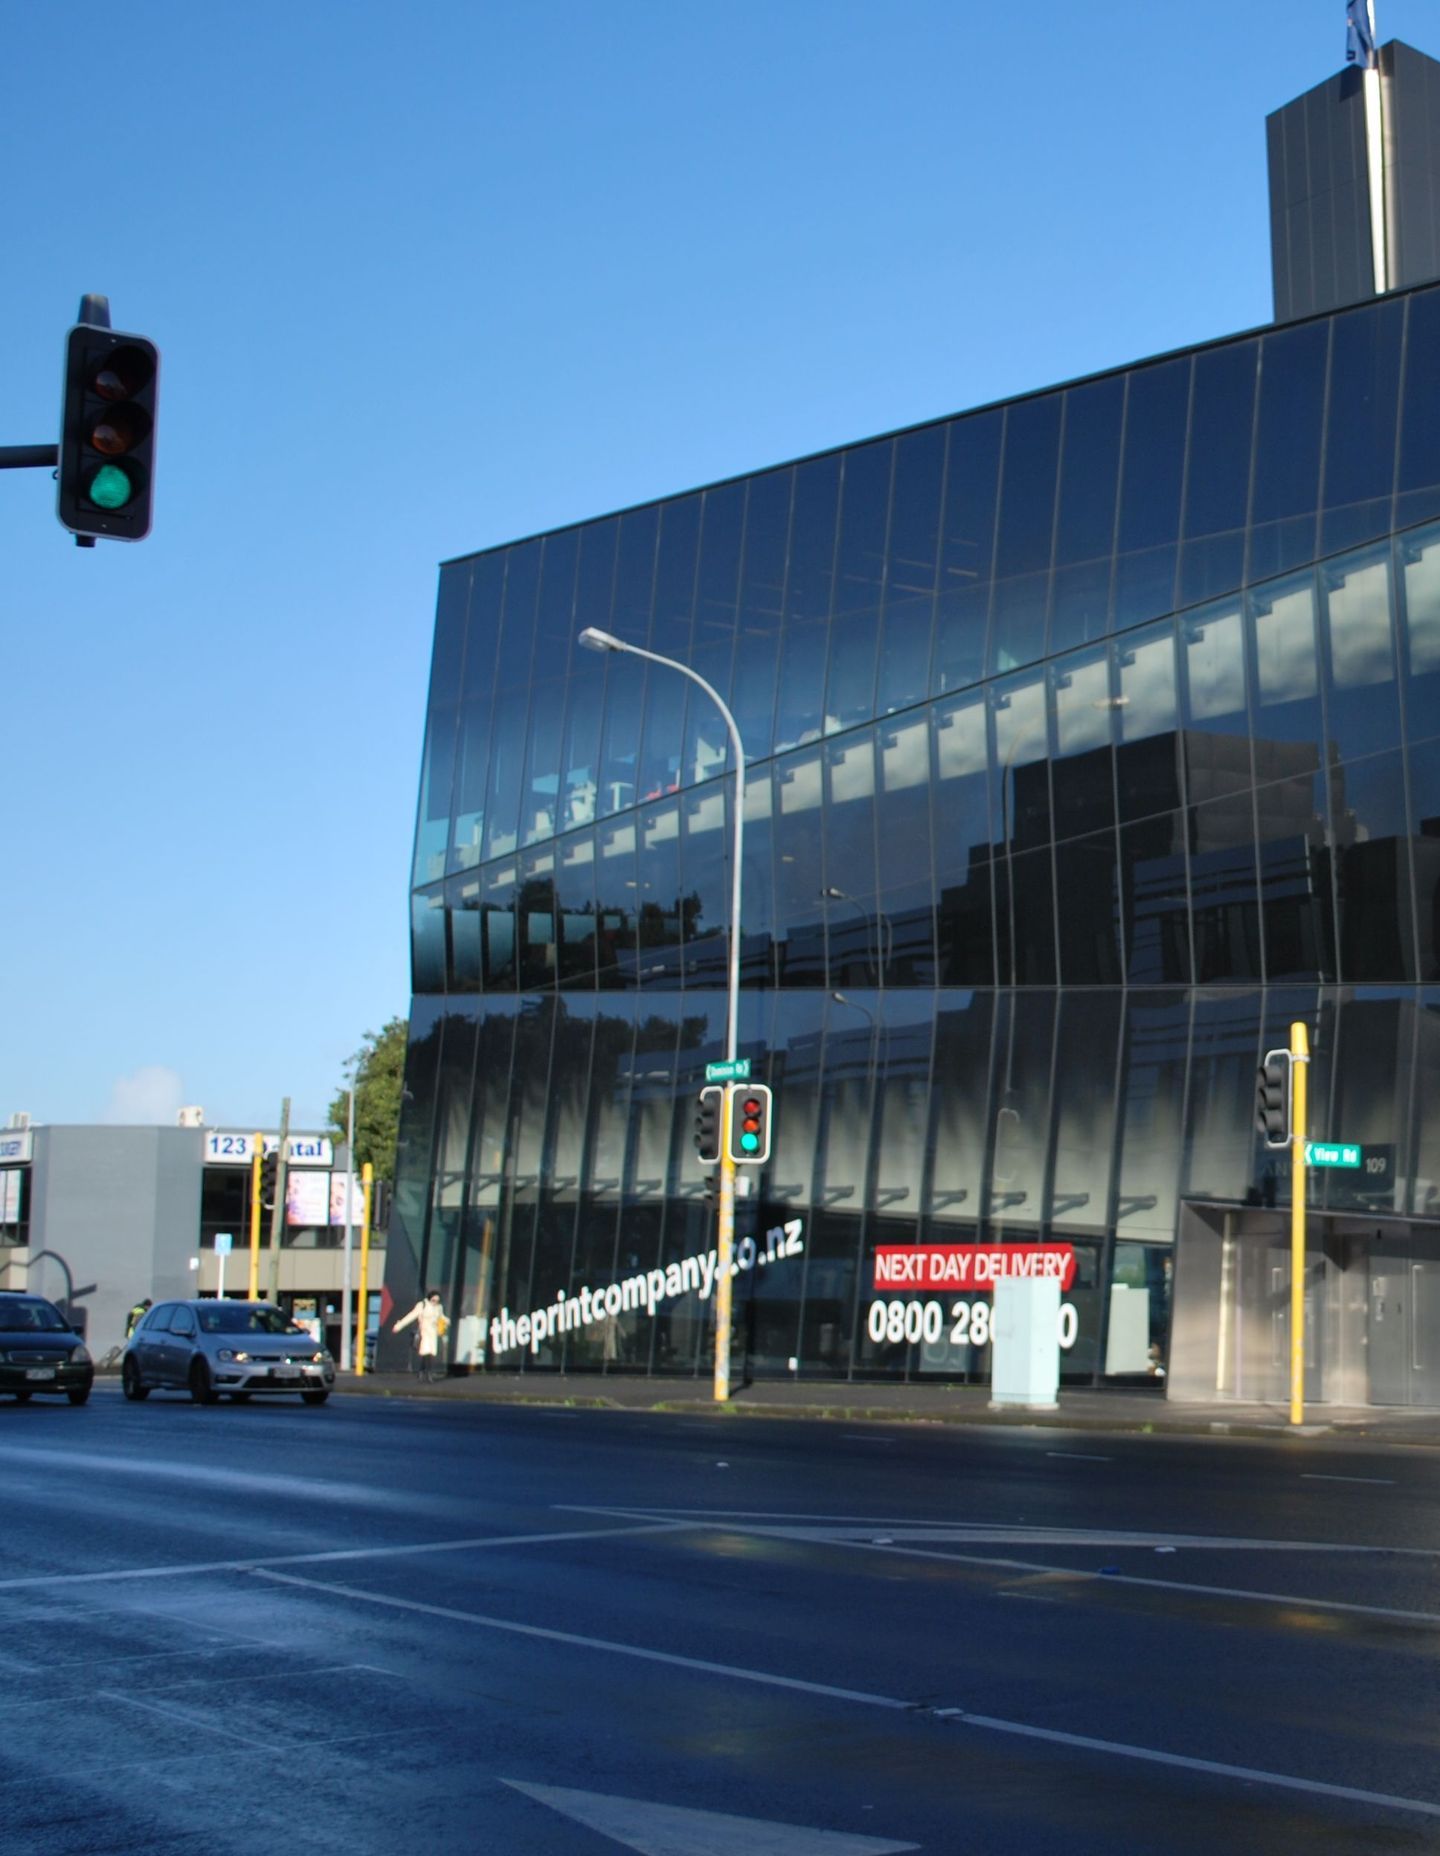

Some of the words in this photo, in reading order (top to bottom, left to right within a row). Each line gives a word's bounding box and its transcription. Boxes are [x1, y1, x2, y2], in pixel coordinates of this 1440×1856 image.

[210, 1136, 246, 1154] 123
[1313, 1147, 1339, 1161] View
[1342, 1148, 1357, 1163] Rd
[1366, 1158, 1387, 1173] 109
[875, 1253, 927, 1281] NEXT
[929, 1253, 971, 1281] DAY
[974, 1252, 1071, 1281] DELIVERY
[868, 1300, 943, 1344] 0800
